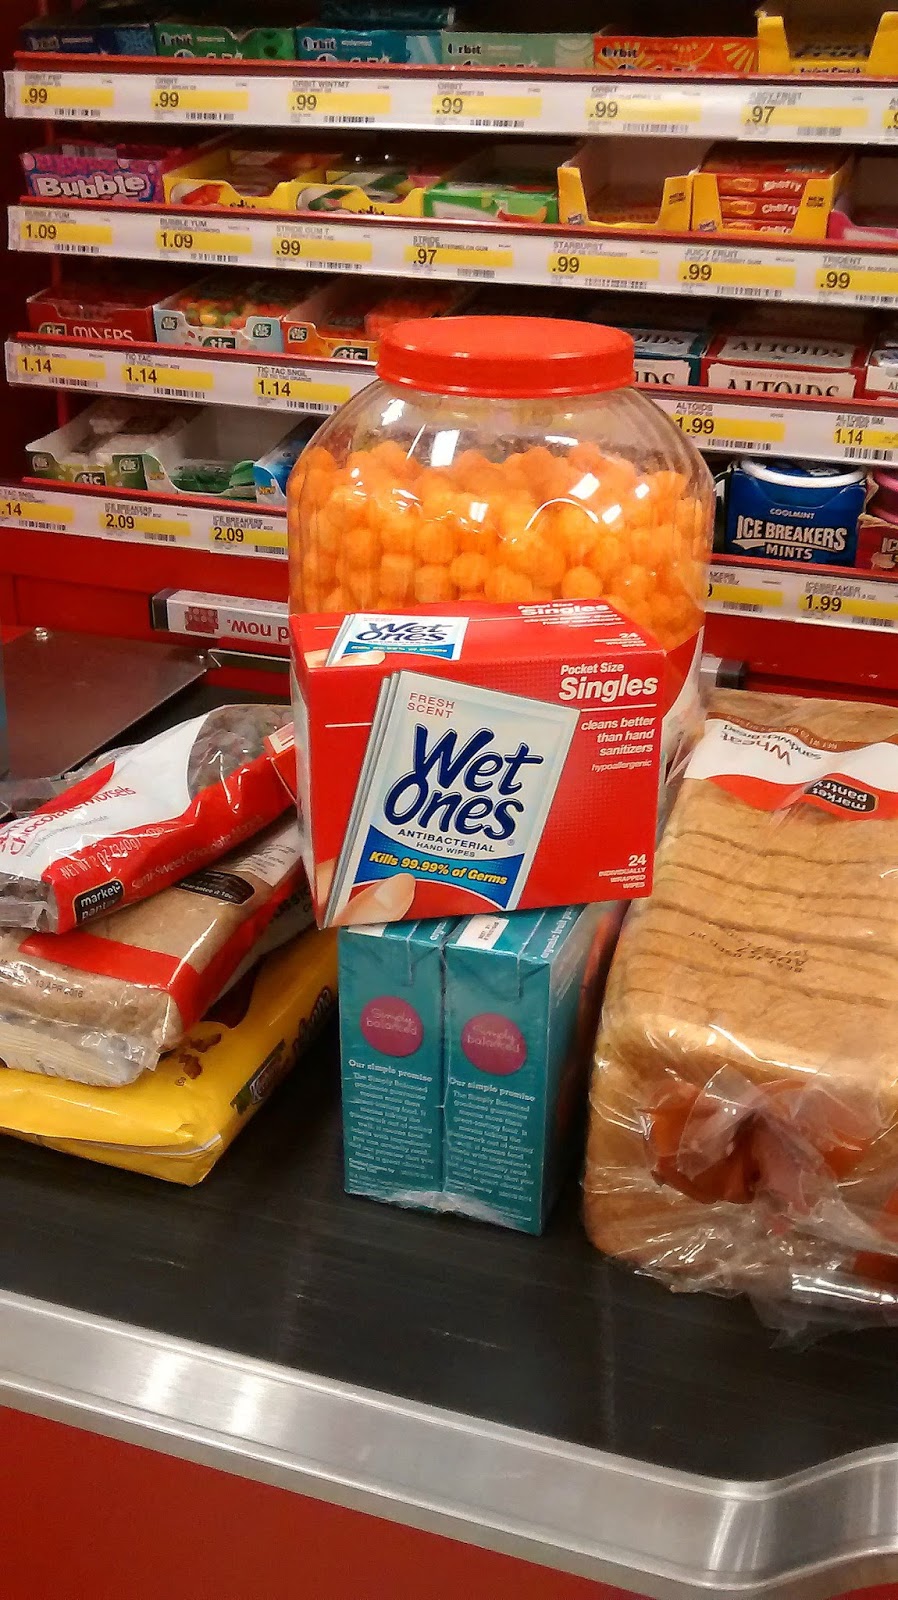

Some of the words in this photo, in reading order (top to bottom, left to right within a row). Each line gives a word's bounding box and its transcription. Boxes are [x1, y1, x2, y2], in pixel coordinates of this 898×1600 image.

[160, 33, 193, 46] Orbit
[303, 37, 336, 51] Orbit
[448, 43, 482, 55] Orbit
[601, 46, 638, 58] Orbit
[24, 88, 48, 104] .99
[155, 92, 179, 108] .99
[292, 95, 318, 111] .99
[435, 97, 463, 114] .99
[589, 101, 618, 118] .99
[746, 105, 775, 124] .97
[36, 176, 147, 198] Bubble
[25, 224, 57, 239] 1.09
[160, 233, 193, 249] 1.09
[276, 240, 301, 256] .99
[413, 249, 437, 265] .97
[552, 256, 580, 273] .99
[683, 264, 712, 281] .99
[820, 271, 851, 289] .99
[209, 338, 232, 349] tic
[22, 356, 52, 373] 1.14
[257, 366, 270, 374] TIC
[126, 366, 157, 383] 1.14
[257, 379, 291, 396] 1.14
[675, 417, 714, 434] 1.99
[835, 428, 864, 445] 1.14
[81, 473, 101, 485] tic
[1, 502, 22, 516] .14
[770, 508, 815, 519] COOLMINT
[106, 513, 135, 529] 2.09
[214, 527, 245, 542] 2.09
[737, 515, 763, 539] ICE
[765, 523, 848, 551] BREAKERS
[766, 543, 813, 560] MINTS
[521, 605, 609, 617] Singles
[805, 594, 842, 612] 1.99
[355, 631, 448, 641] Ones
[369, 622, 453, 633] Wet
[560, 663, 598, 676] Pocket
[600, 662, 625, 673] Size
[559, 674, 659, 703] Singles
[409, 692, 455, 709] FRESH
[407, 702, 453, 719] SCENT
[581, 719, 619, 731] cleans
[620, 716, 656, 728] better
[597, 732, 623, 743] than
[625, 729, 655, 740] hand
[600, 743, 654, 757] sanitizers
[720, 731, 792, 766] Wheat
[413, 722, 544, 796] Wet
[592, 759, 653, 772] hypoallergenic
[811, 787, 867, 812] market
[812, 779, 867, 803] pantry
[383, 770, 525, 841] Ones
[398, 828, 496, 853] ANTIBACTERIAL
[416, 841, 444, 853] HAND
[446, 846, 476, 858] WIPES
[369, 851, 398, 867] Kills
[401, 857, 449, 876] 99.99%
[452, 867, 467, 878] of
[467, 868, 508, 885] Germs
[628, 853, 647, 867] 24
[60, 863, 78, 880] NET
[598, 867, 647, 877] INDIVIDUALLY
[610, 874, 646, 883] WRAPPED
[80, 882, 121, 908] market
[46, 983, 63, 993] APR
[366, 1018, 418, 1036] balanced
[467, 1034, 521, 1053] balanced
[348, 1059, 365, 1069] Our
[367, 1063, 396, 1074] simple
[398, 1070, 433, 1083] promise
[467, 1081, 498, 1093] simple
[500, 1088, 536, 1102] promise
